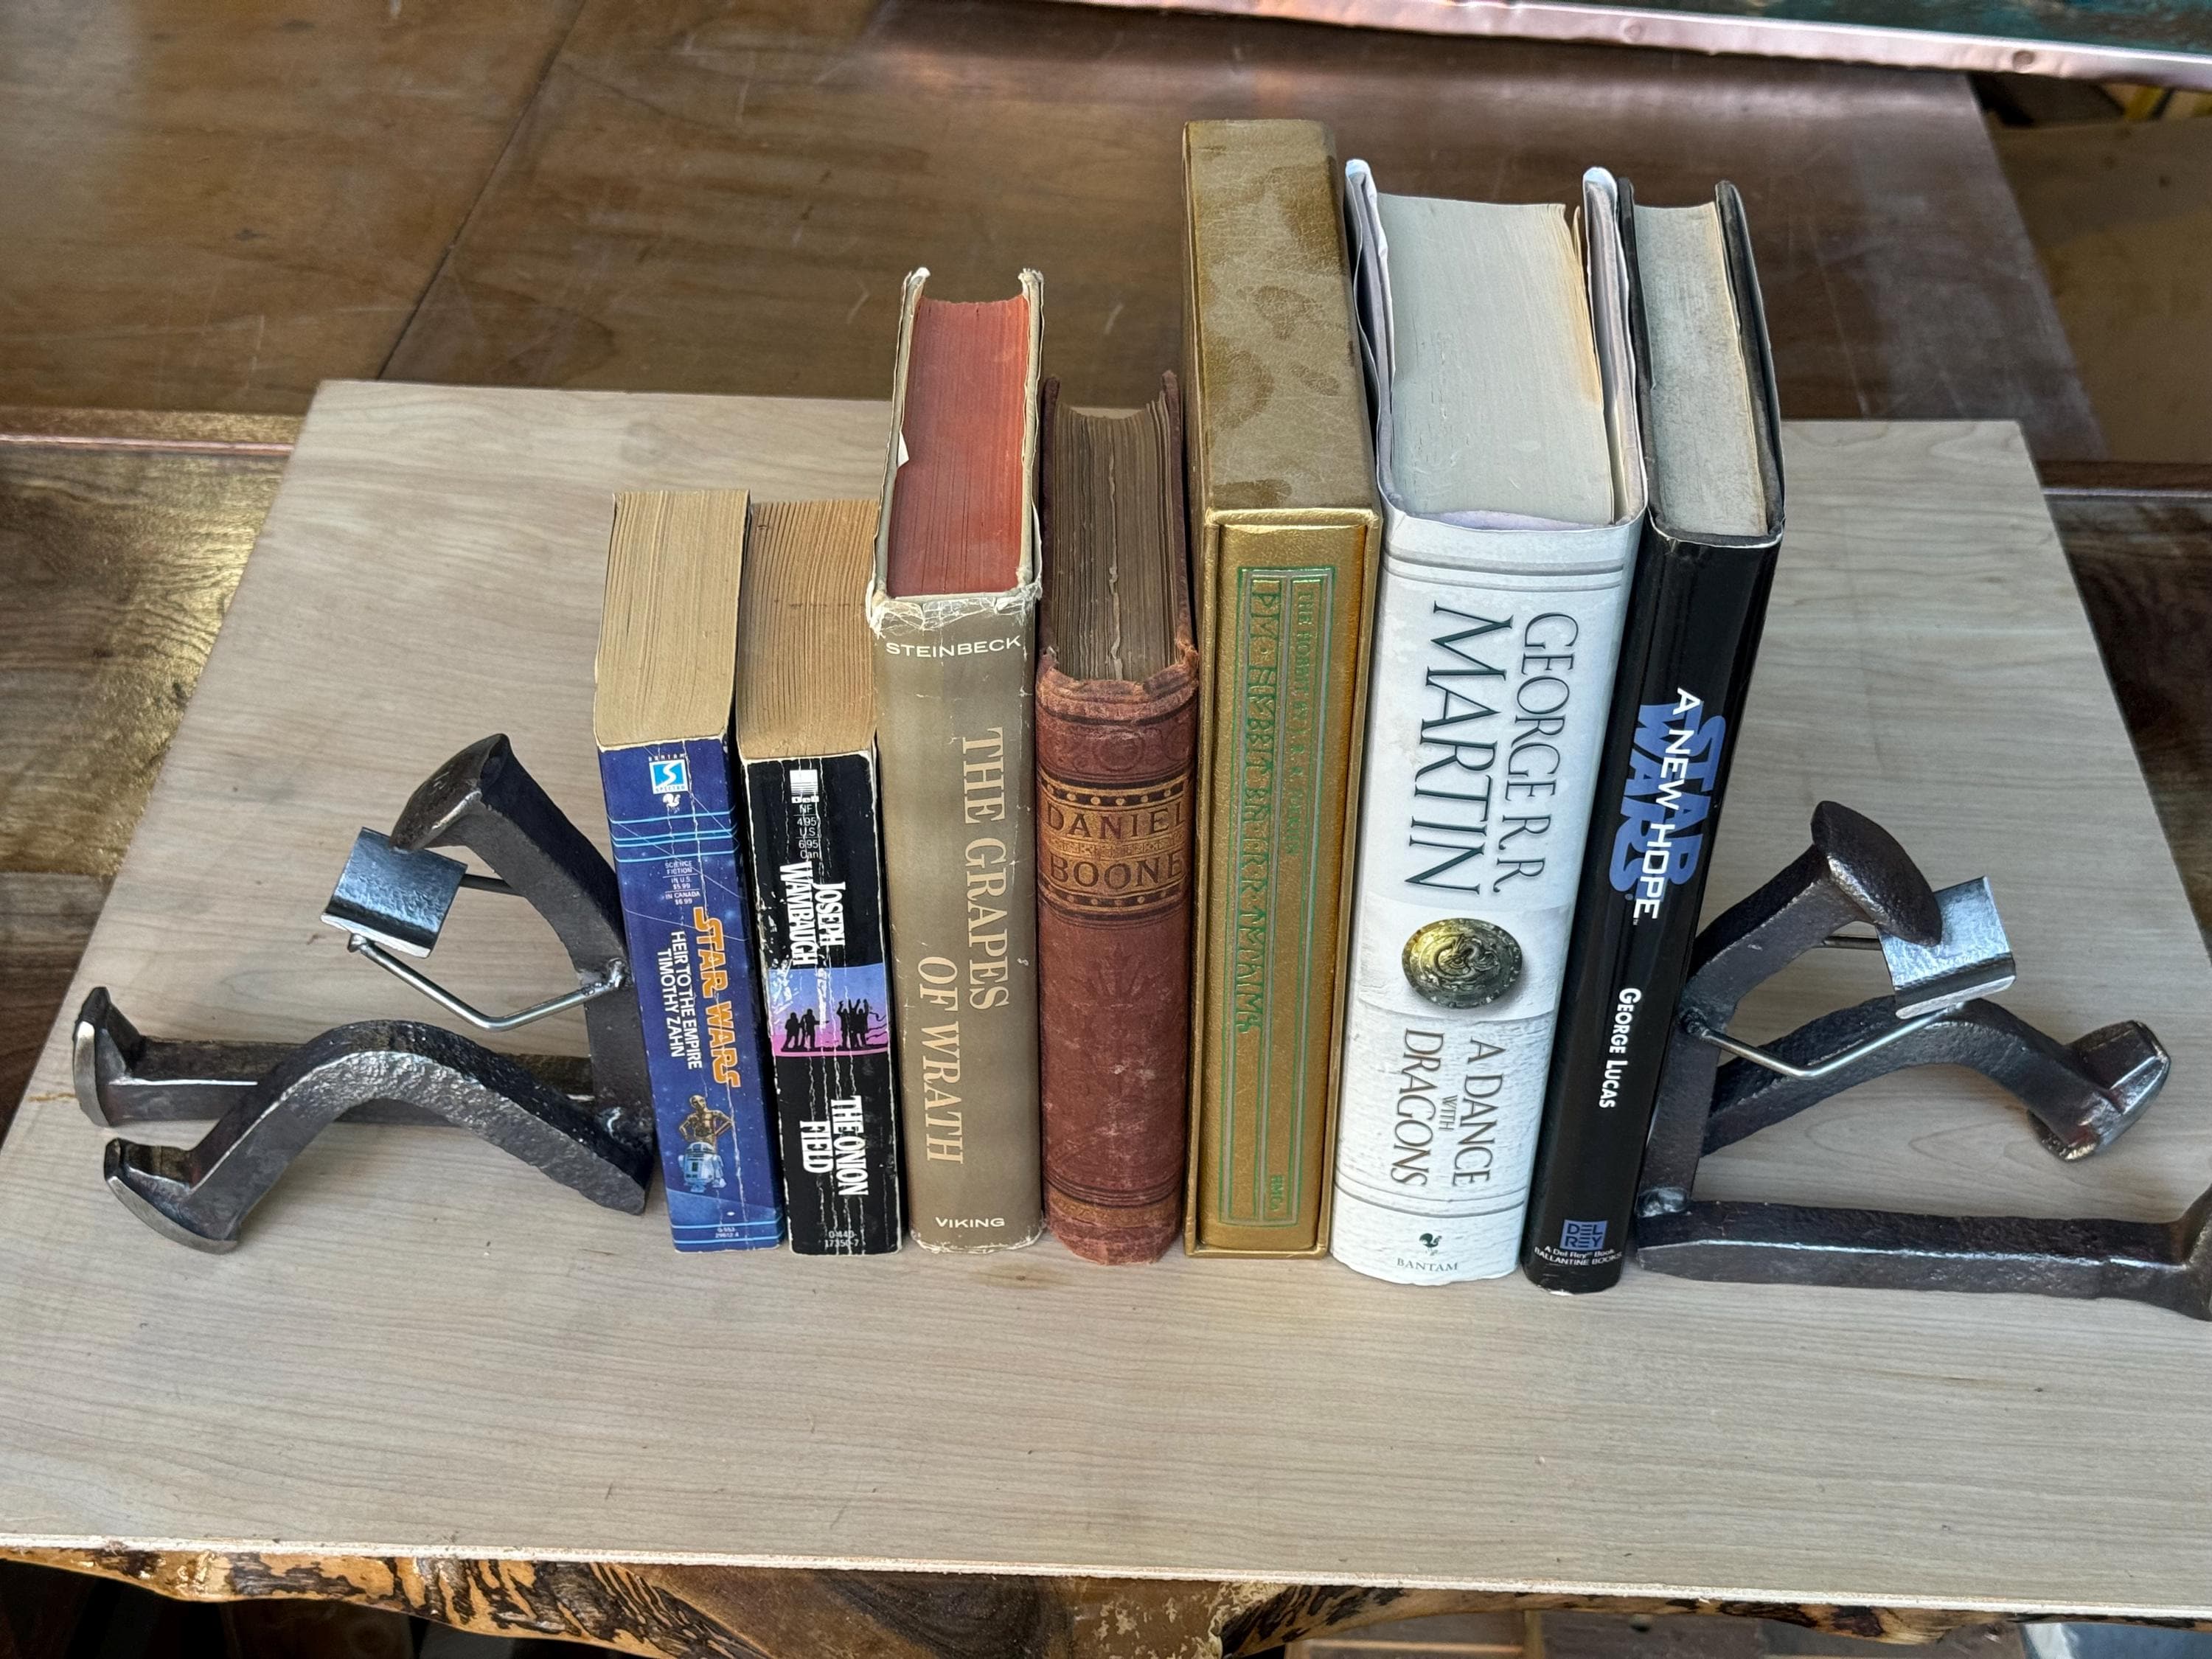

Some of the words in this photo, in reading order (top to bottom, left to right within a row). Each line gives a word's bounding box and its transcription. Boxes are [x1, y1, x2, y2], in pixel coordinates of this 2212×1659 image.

[886, 635, 1021, 658] STEINBECK
[1505, 612, 1579, 802] GEORGE
[1672, 687, 1701, 715] A
[1404, 600, 1514, 896] MARTIN
[1656, 728, 1695, 811] NEW
[962, 727, 1006, 824] THE
[1047, 801, 1186, 839] DANIEL
[665, 860, 692, 869] SCIENCE
[1049, 849, 1186, 890] BOONE
[1632, 822, 1676, 919] HOPE
[674, 891, 700, 899] CANADA
[779, 860, 820, 966] WAMBAUGH
[811, 881, 846, 947] JOSEPH
[671, 931, 689, 964] HEIR
[964, 838, 1009, 1009] GRAPES
[675, 964, 692, 987] TO
[693, 906, 726, 998] STAR
[657, 947, 680, 1013] TIMOTHY
[678, 986, 696, 1018] THE
[917, 956, 959, 1012] OF
[666, 1016, 686, 1057] ZAHN
[683, 1018, 703, 1070] EMPIRE
[706, 1000, 741, 1088] WARS
[1608, 987, 1643, 1054] GEORGE
[1467, 1036, 1506, 1065] A
[922, 1020, 964, 1164] WRATH
[1390, 1027, 1446, 1188] DRAGONS
[1599, 1060, 1629, 1109] LUCAS
[831, 1095, 864, 1134] THE
[1439, 1094, 1459, 1133] WITH
[1452, 1074, 1504, 1188] DANCE
[799, 1120, 834, 1174] FIELD
[833, 1135, 869, 1197] ONION
[935, 1215, 1006, 1229] VIKING
[1564, 1236, 1602, 1248] REY
[1567, 1223, 1604, 1236] DEL
[1397, 1258, 1459, 1273] BANTAM
[1534, 1246, 1590, 1266] BALLANTINE
[1591, 1251, 1622, 1266] BOOKS
